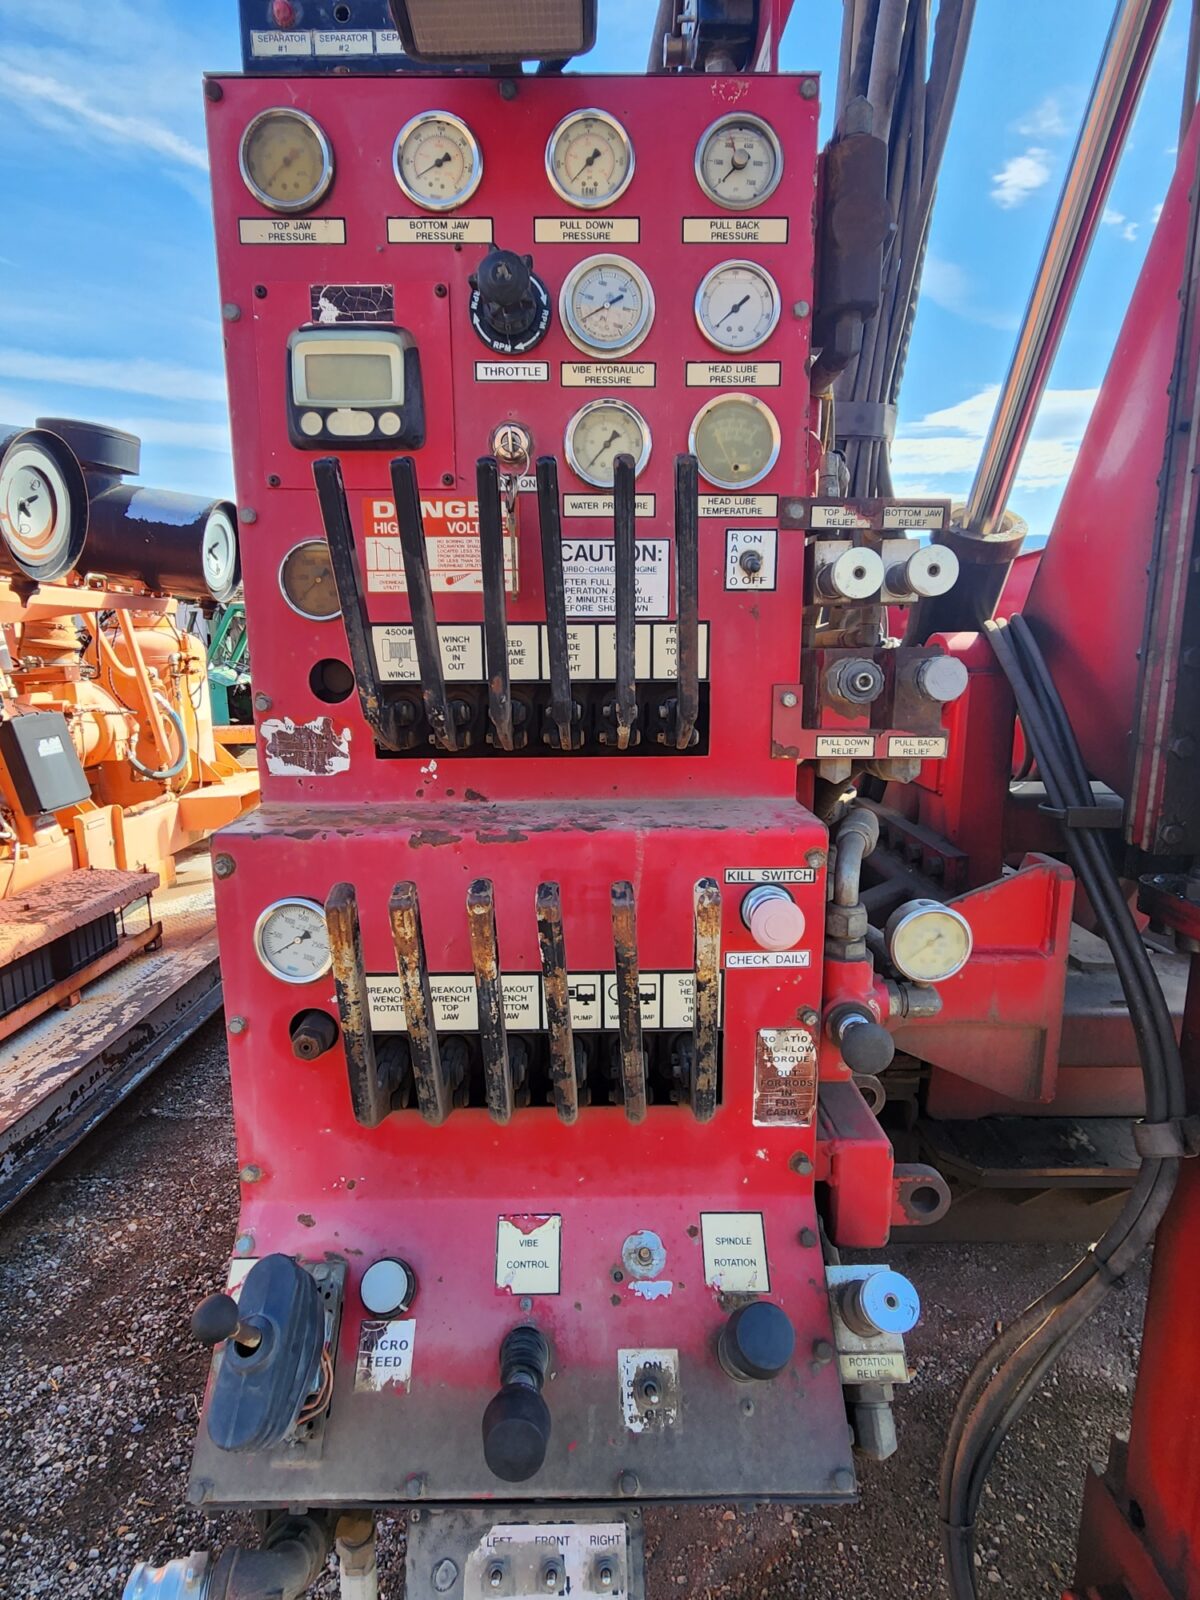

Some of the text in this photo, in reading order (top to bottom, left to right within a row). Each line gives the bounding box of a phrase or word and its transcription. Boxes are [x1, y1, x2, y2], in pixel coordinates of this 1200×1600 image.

[257, 34, 307, 43] SEPARATOR
[319, 34, 368, 42] SEPARATOR
[338, 44, 350, 52] #2
[272, 222, 312, 231] TOP JAW
[409, 221, 470, 230] BOTTOM JAW
[560, 221, 614, 230] PULL DOWN
[710, 221, 760, 230] PULL BACK
[268, 233, 317, 241] PRESSURE
[416, 232, 464, 240] PRESSURE
[562, 232, 611, 240] PRESSURE
[711, 232, 759, 240] PRESSURE
[470, 289, 480, 310] RPM
[539, 309, 549, 330] RPM
[493, 341, 511, 353] RPM
[483, 367, 541, 376] THROTTLE
[572, 366, 645, 375] VIBE HYDRAULIC
[585, 376, 632, 384] PRESSURE
[710, 375, 756, 384] PRESSURE
[708, 498, 731, 506] HEAD
[885, 508, 942, 517] BOTTOM JAW
[373, 522, 398, 535] HIG
[743, 535, 762, 543] ON
[564, 578, 612, 586] FTER FULL
[742, 576, 767, 585] OFF
[565, 587, 608, 595] PERATION
[576, 595, 616, 603] MINUTES
[565, 604, 593, 612] EFORE
[385, 628, 413, 636] 4500#
[442, 635, 470, 643] WINCH
[727, 871, 813, 881] KILL SWITCH
[728, 955, 807, 965] CHECK DAILY
[768, 1055, 810, 1063] TORQUE
[780, 1089, 792, 1097] IN
[766, 1108, 806, 1116] CASING
[519, 1239, 538, 1247] VIBE
[715, 1237, 752, 1246] SPINDLE
[506, 1260, 550, 1269] CONTROL
[714, 1258, 757, 1267] ROTATION
[363, 1340, 409, 1350] MICRO
[366, 1356, 402, 1367] FEED
[643, 1361, 663, 1371] ON
[849, 1357, 894, 1367] ROTATION
[589, 1535, 621, 1546] RIGHT
